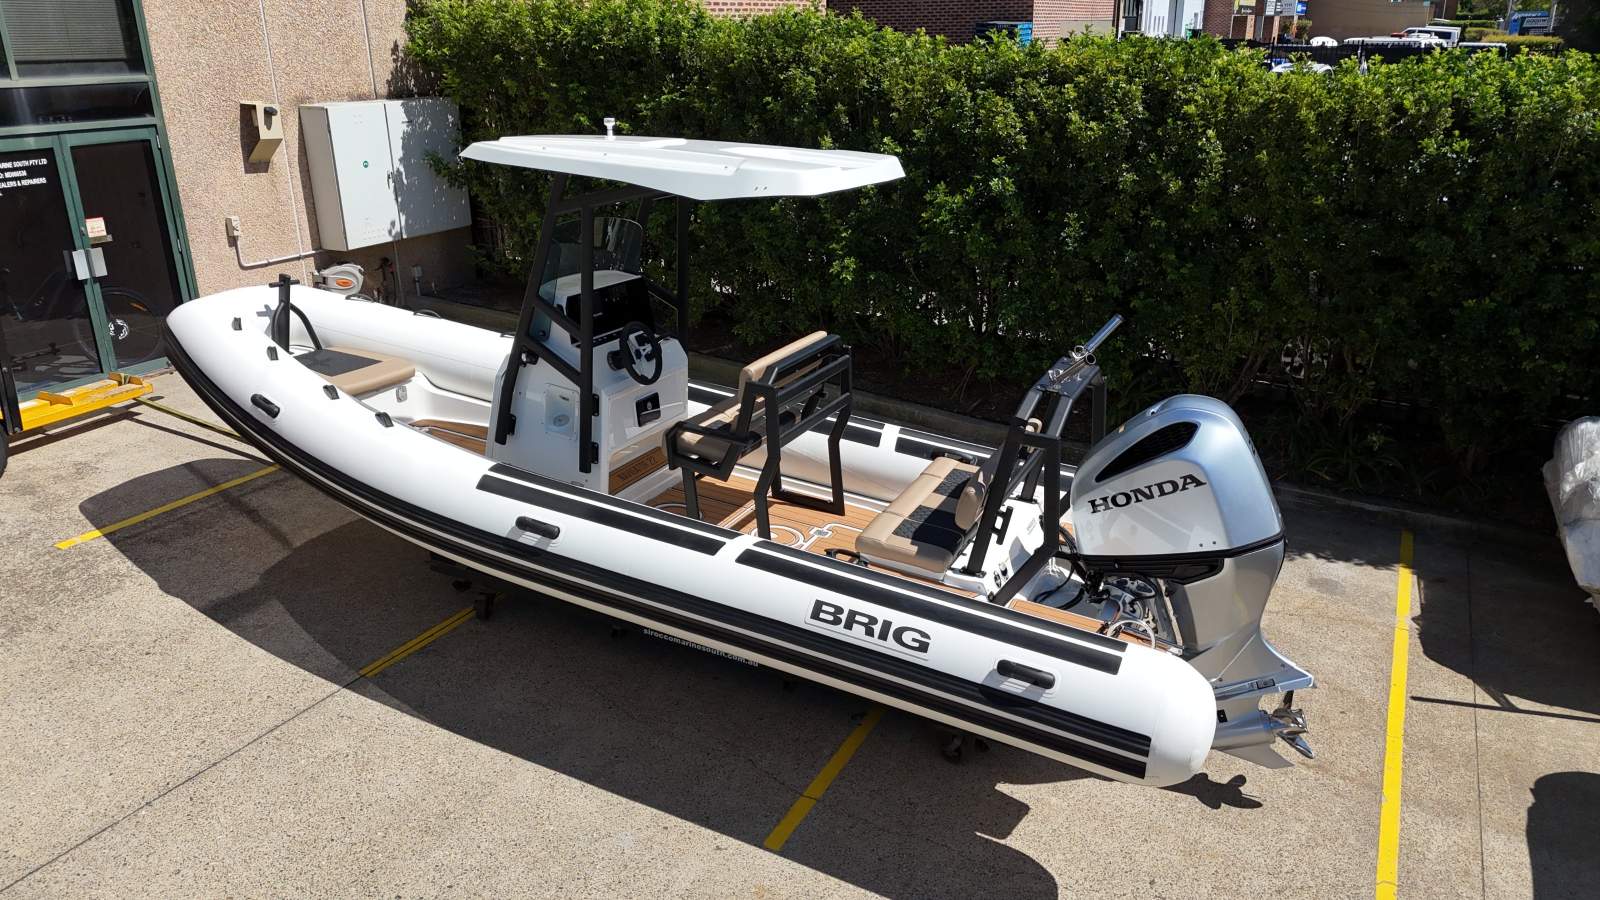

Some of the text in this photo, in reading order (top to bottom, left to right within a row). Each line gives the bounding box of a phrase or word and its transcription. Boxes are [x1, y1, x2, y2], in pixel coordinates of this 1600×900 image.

[21, 177, 47, 185] REPAIRERS
[1088, 474, 1207, 514] HONDA
[810, 599, 932, 654] BRIG
[643, 628, 759, 667] siroccomarinesouth.com.au
